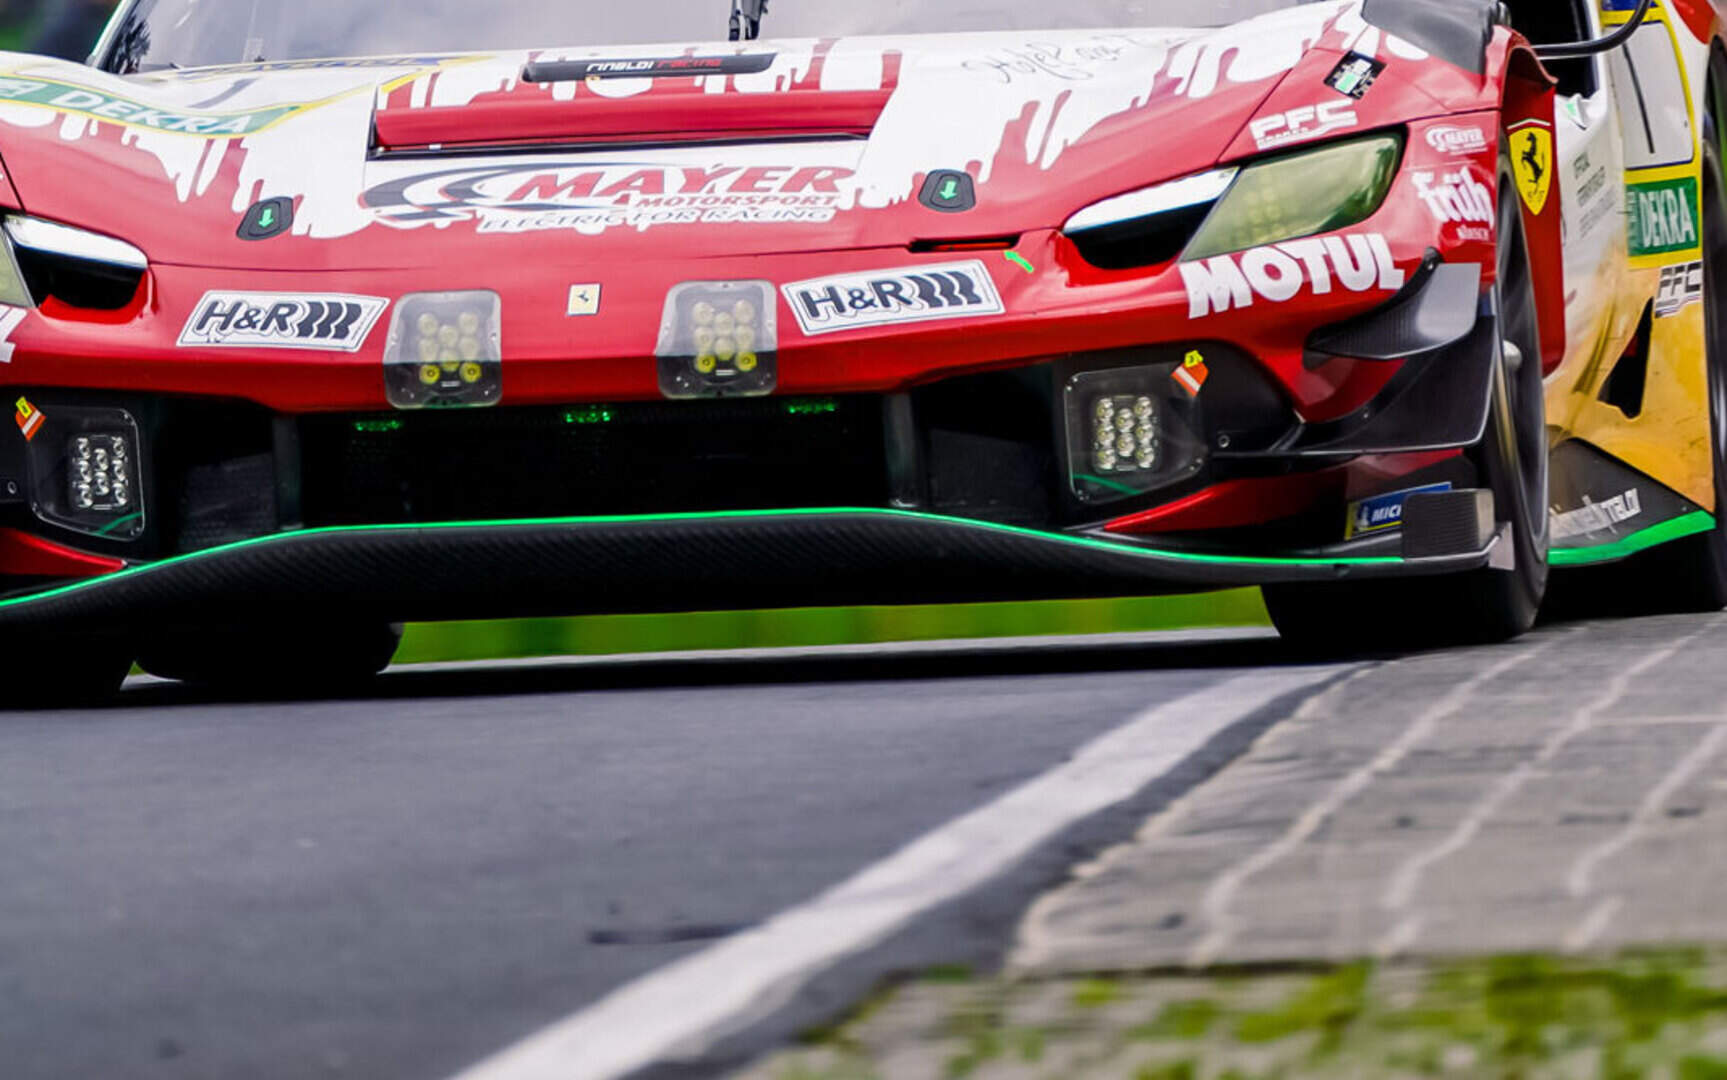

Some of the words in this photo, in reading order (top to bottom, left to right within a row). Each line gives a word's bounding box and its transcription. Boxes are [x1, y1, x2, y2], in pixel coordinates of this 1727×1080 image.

[48, 90, 251, 134] DEKRA
[1250, 98, 1358, 140] PFC
[504, 165, 856, 203] MAYER
[636, 195, 840, 208] MOTORSPORT
[483, 209, 622, 230] ELECTRIC
[634, 208, 697, 223] FOR
[702, 207, 833, 221] RACING
[1639, 187, 1696, 248] DEKRA
[1179, 233, 1405, 320] MOTUL
[195, 300, 299, 332] H&R
[800, 279, 913, 318] H&R
